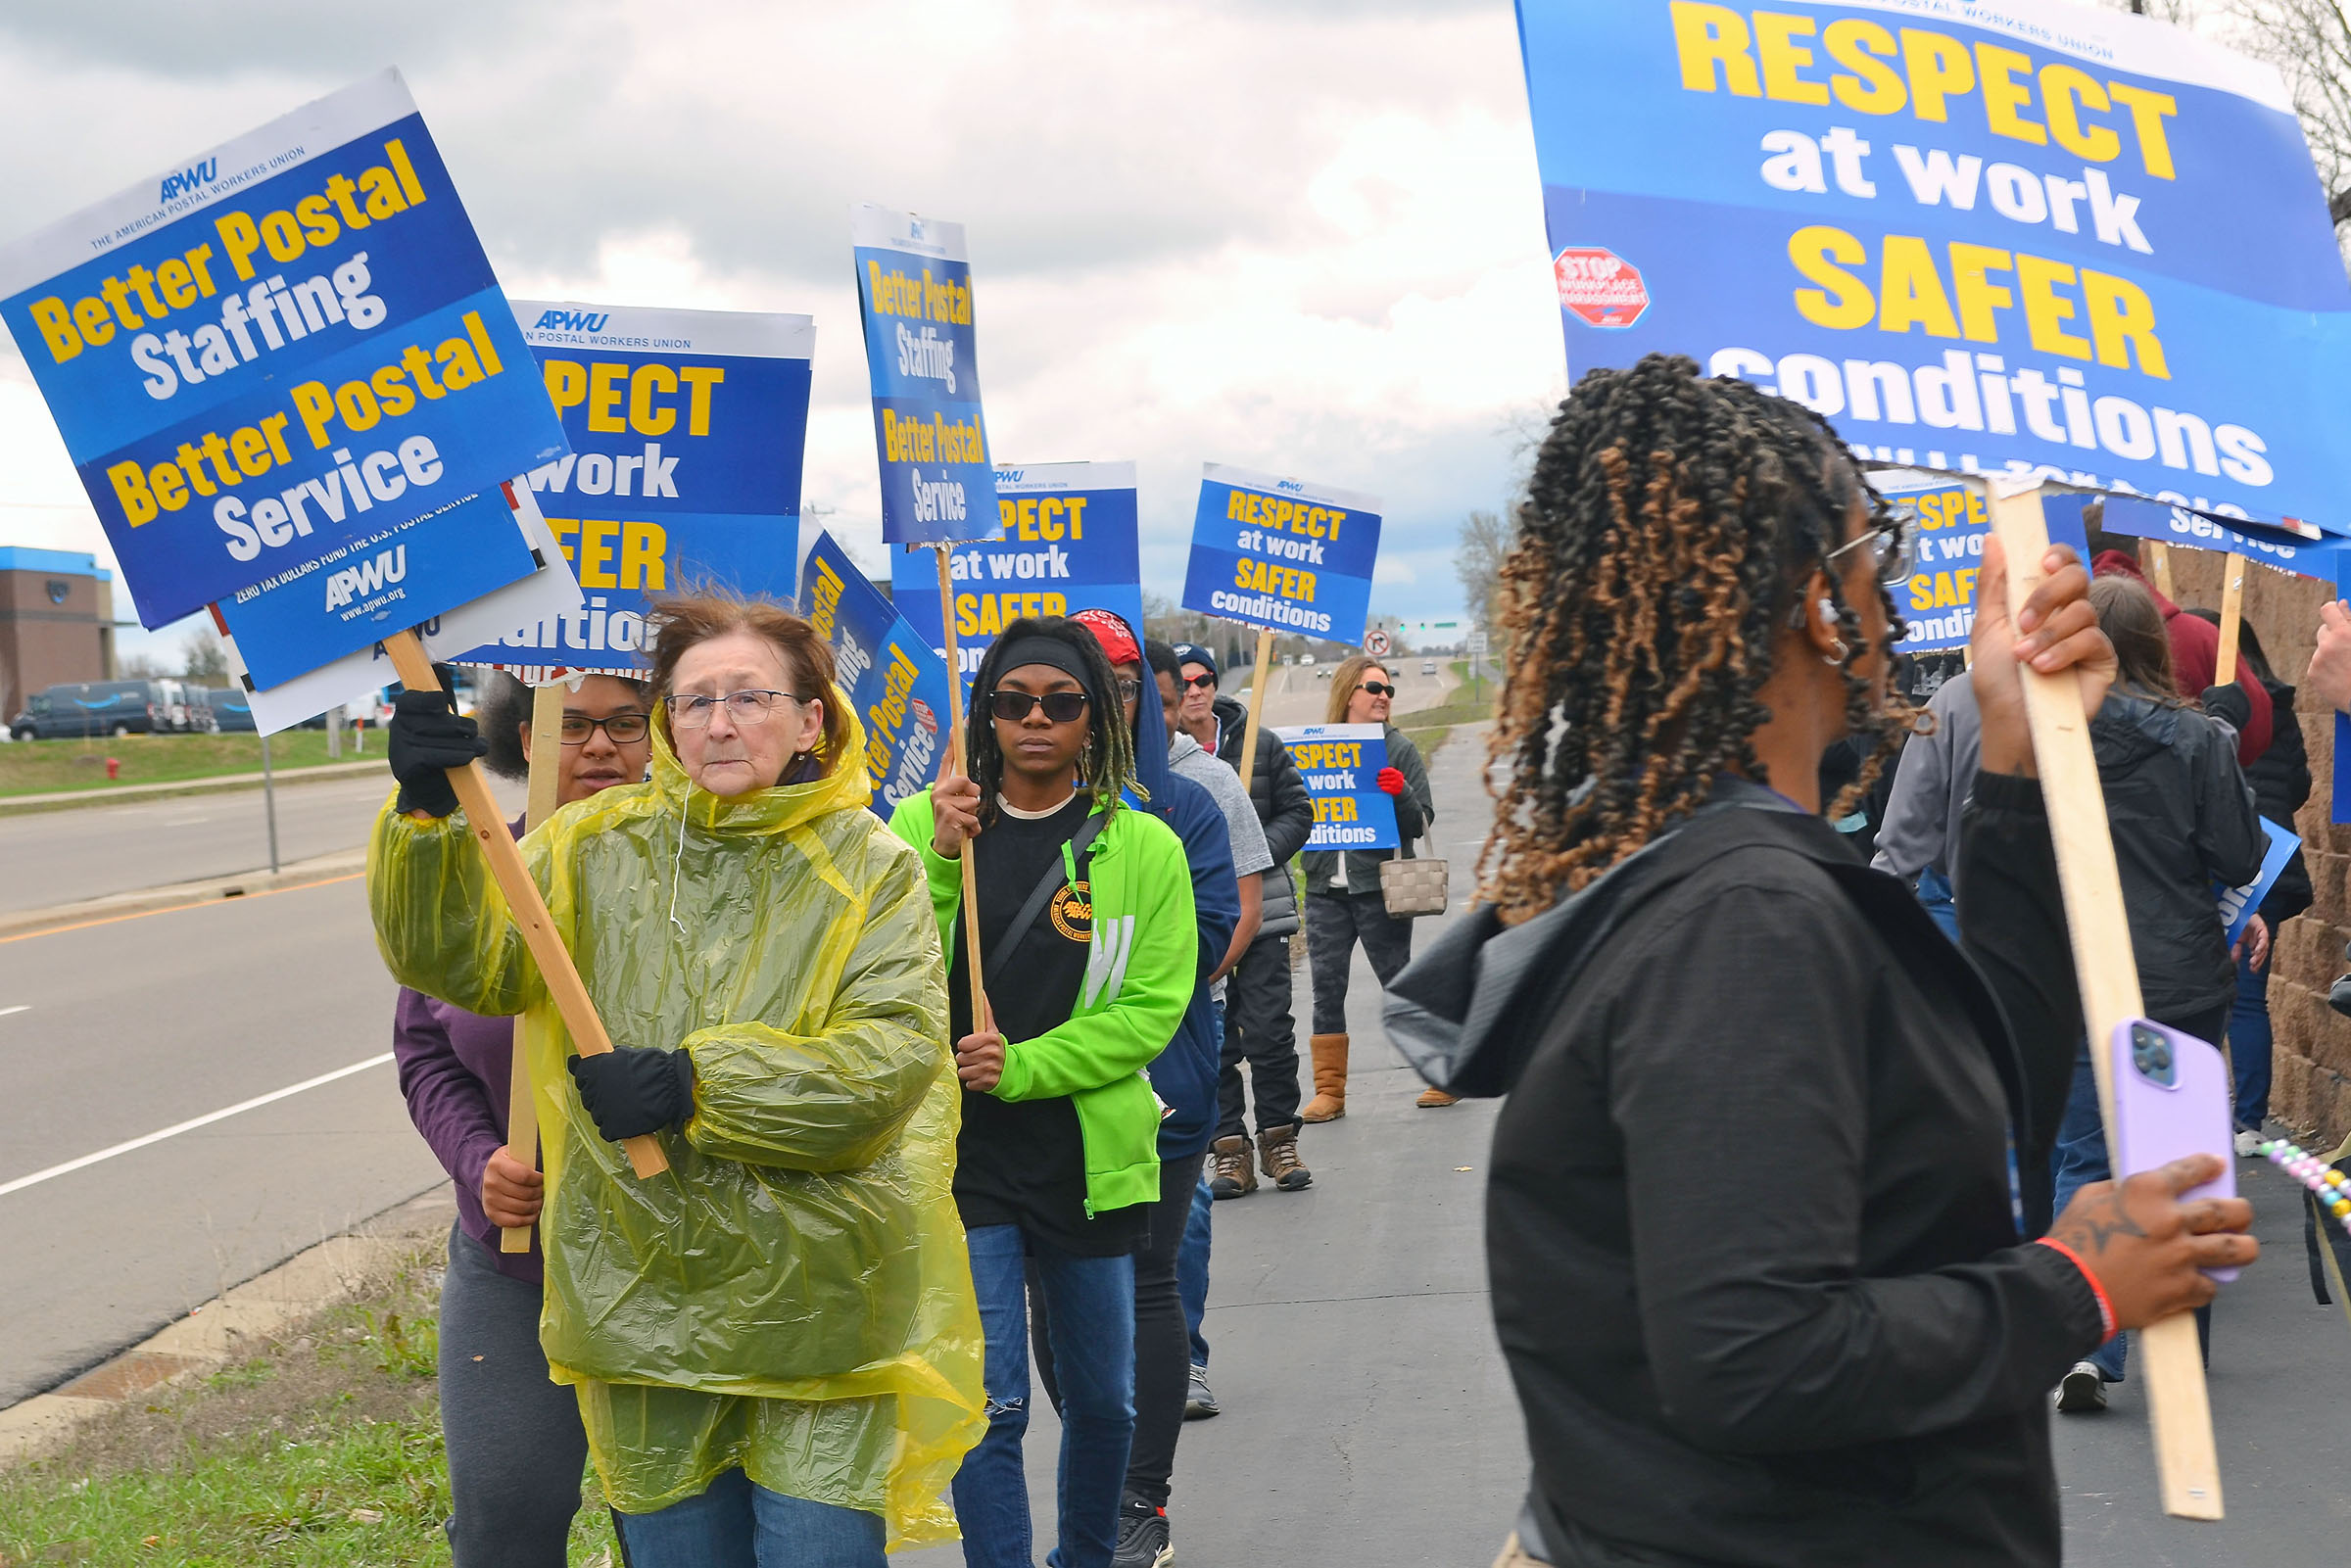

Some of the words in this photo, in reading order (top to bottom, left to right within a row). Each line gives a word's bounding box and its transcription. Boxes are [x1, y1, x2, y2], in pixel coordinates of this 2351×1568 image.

[1962, 5, 2053, 41] WORKERS
[2058, 32, 2114, 61] UNION
[1669, 1, 2179, 181] RESPECT
[90, 234, 114, 251] THE
[116, 210, 167, 240] AMERICAN
[168, 191, 210, 215] POSTAL
[210, 163, 268, 195] WORKERS
[269, 145, 307, 169] UNION
[161, 157, 216, 204] APWU
[1760, 126, 1878, 199] at
[1892, 143, 2154, 256] work
[29, 242, 216, 364] Better
[215, 138, 427, 281] Postal
[1559, 256, 1622, 279] STOP
[868, 260, 922, 319] Better
[922, 268, 972, 326] Postal
[1787, 225, 2173, 382] SAFER
[131, 251, 389, 402] Staffing
[534, 309, 609, 333] APWU
[539, 332, 585, 344] POSTAL
[590, 335, 649, 347] WORKERS
[653, 339, 692, 349] UNION
[896, 321, 956, 395] Staffing
[107, 409, 292, 530] Better
[290, 310, 504, 451] Postal
[544, 359, 725, 437] PECT
[882, 407, 936, 463] Better
[934, 410, 985, 464] Postal
[526, 443, 680, 499] work
[911, 467, 967, 523] Service
[994, 470, 1024, 482] PWU
[213, 435, 445, 562] Service
[996, 497, 1087, 542] PECT
[1226, 490, 1347, 542] RESPECT
[544, 517, 667, 591] FER
[950, 550, 983, 580] at
[987, 544, 1070, 580] work
[1236, 529, 1264, 552] at
[1266, 535, 1325, 565] work
[1938, 533, 1985, 560] wo
[235, 585, 261, 604] ZERO
[261, 578, 280, 593] TAX
[325, 544, 407, 613] APWU
[340, 588, 407, 623] www.apwu.org
[803, 556, 845, 641] ostal
[1234, 557, 1317, 603] SAFER
[1909, 567, 1981, 611] SAF
[1211, 590, 1332, 633] conditions
[869, 642, 919, 744] Postal
[1285, 743, 1362, 770] SPECT
[1308, 769, 1356, 790] work
[1305, 824, 1376, 844] ditions
[1310, 796, 1359, 823] AFER
